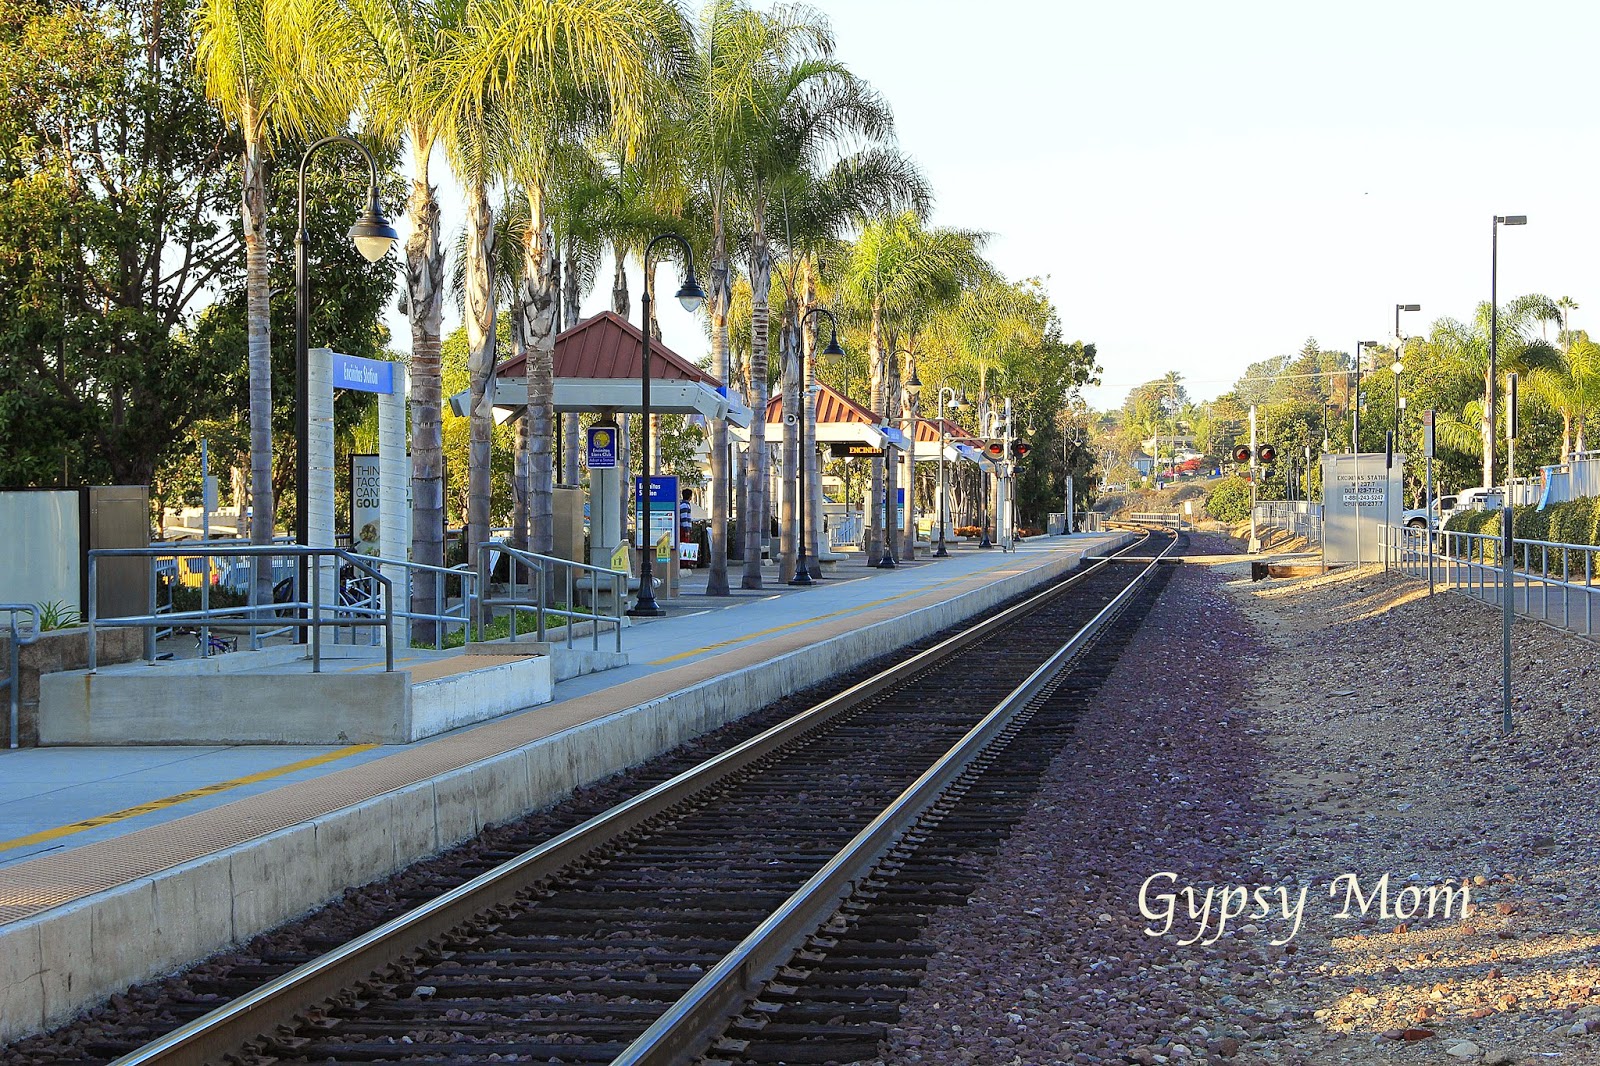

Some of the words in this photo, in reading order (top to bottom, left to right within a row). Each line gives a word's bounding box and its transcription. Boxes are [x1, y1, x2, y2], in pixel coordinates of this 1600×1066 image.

[344, 362, 362, 382] Encinitas
[363, 365, 378, 385] Station
[356, 488, 380, 497] CAN'
